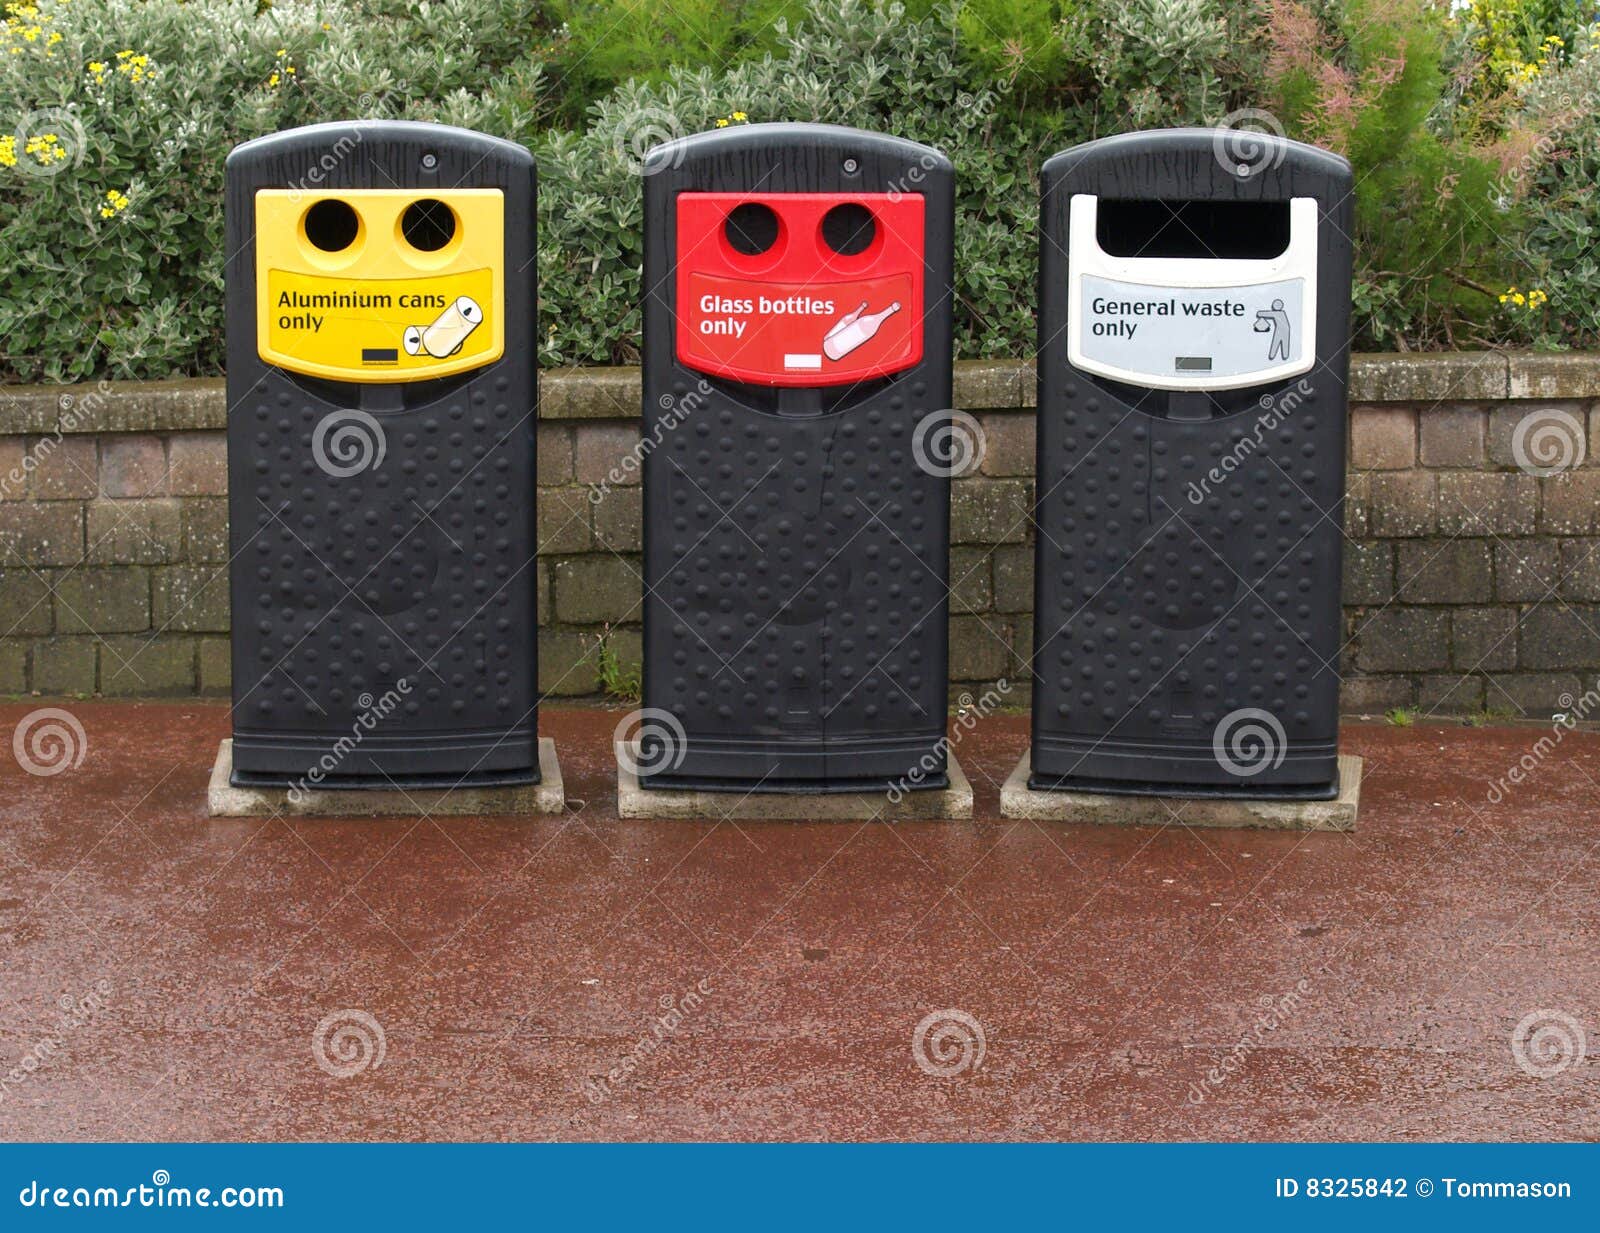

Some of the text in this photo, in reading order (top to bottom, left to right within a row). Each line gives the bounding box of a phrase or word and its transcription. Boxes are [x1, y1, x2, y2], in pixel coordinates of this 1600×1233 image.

[278, 290, 445, 308] Aluminium cans
[700, 295, 834, 315] Glass bottles
[1092, 298, 1246, 317] General waste
[278, 313, 323, 332] only
[700, 317, 747, 339] only
[1092, 320, 1138, 340] only
